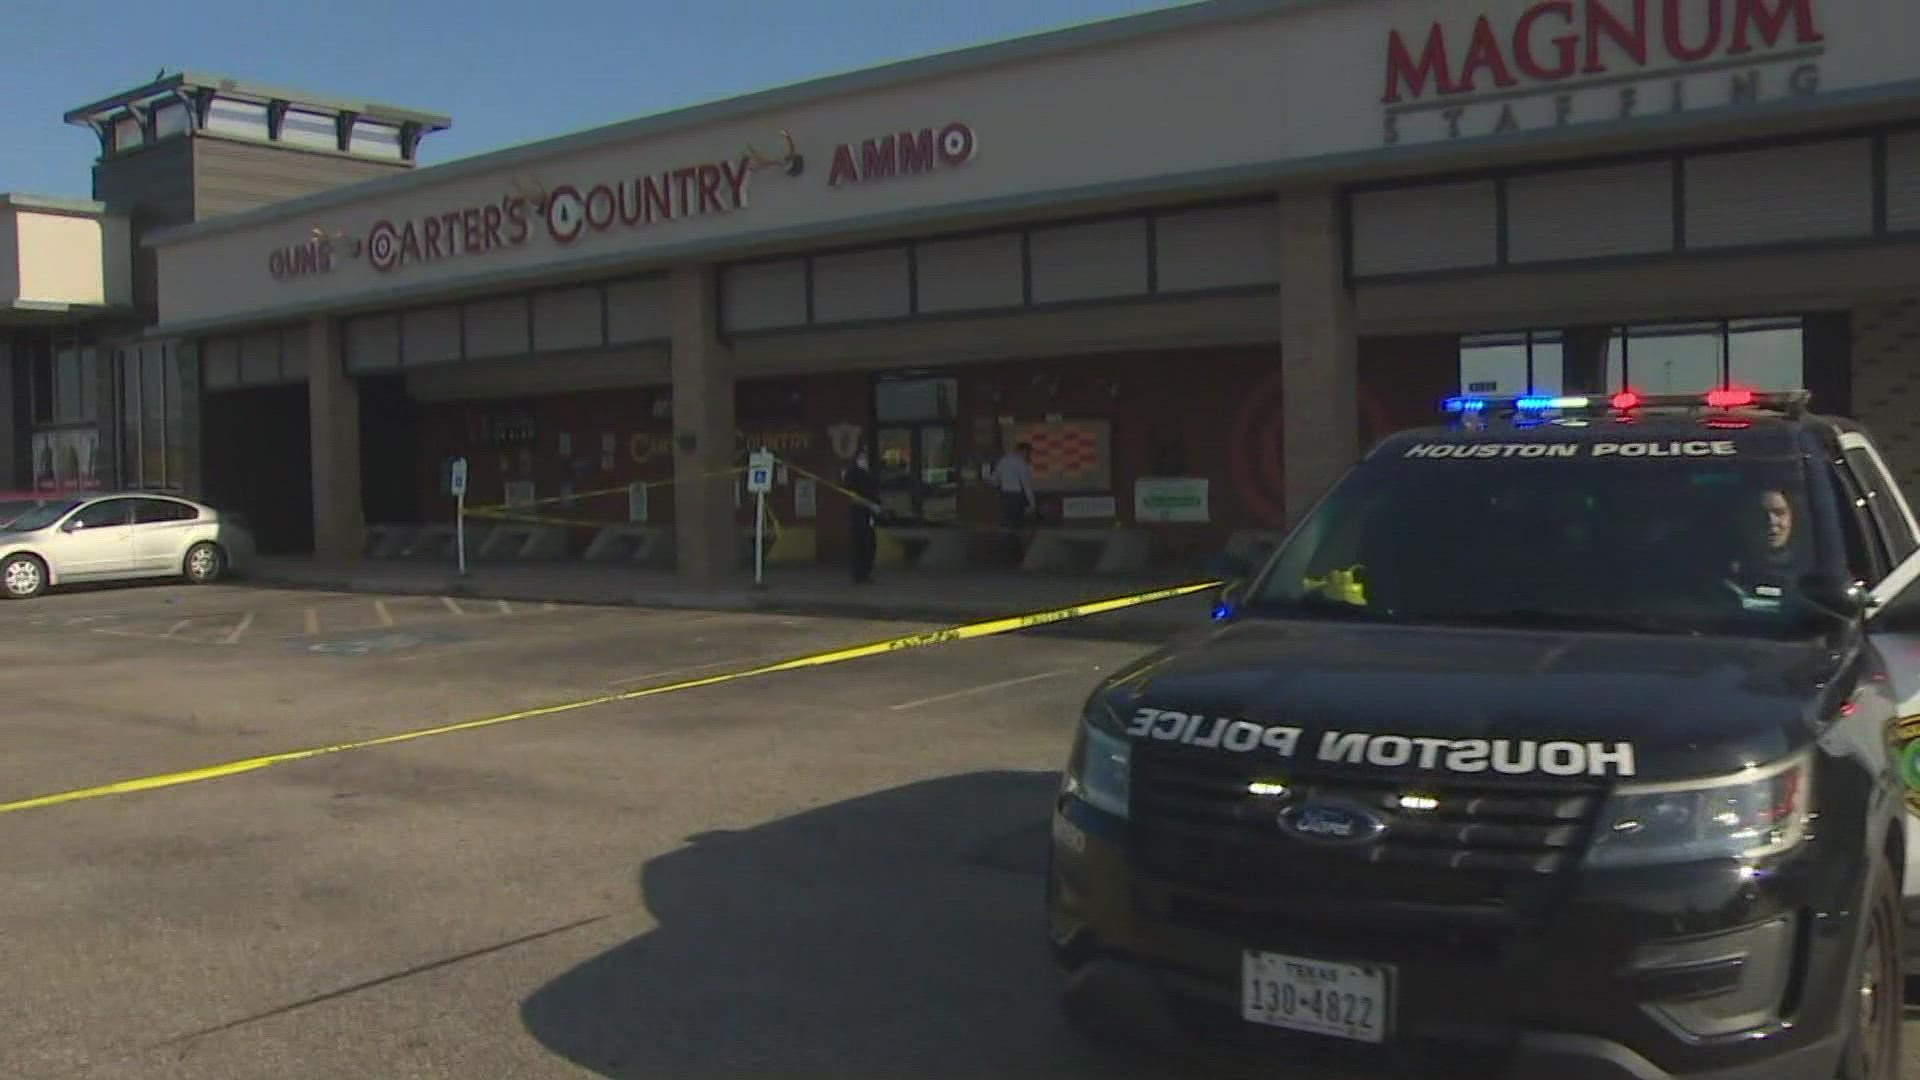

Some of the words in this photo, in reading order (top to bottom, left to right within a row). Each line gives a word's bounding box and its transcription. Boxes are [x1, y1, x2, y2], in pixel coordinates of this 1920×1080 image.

[1382, 0, 1825, 103] MAGNUM
[1384, 65, 1821, 144] STAFFING
[829, 122, 979, 187] AMMO
[368, 196, 530, 272] CARTER'S
[547, 156, 752, 244] COUNTRY
[1404, 440, 1578, 459] HOUSTON
[1591, 440, 1738, 457] POLICE
